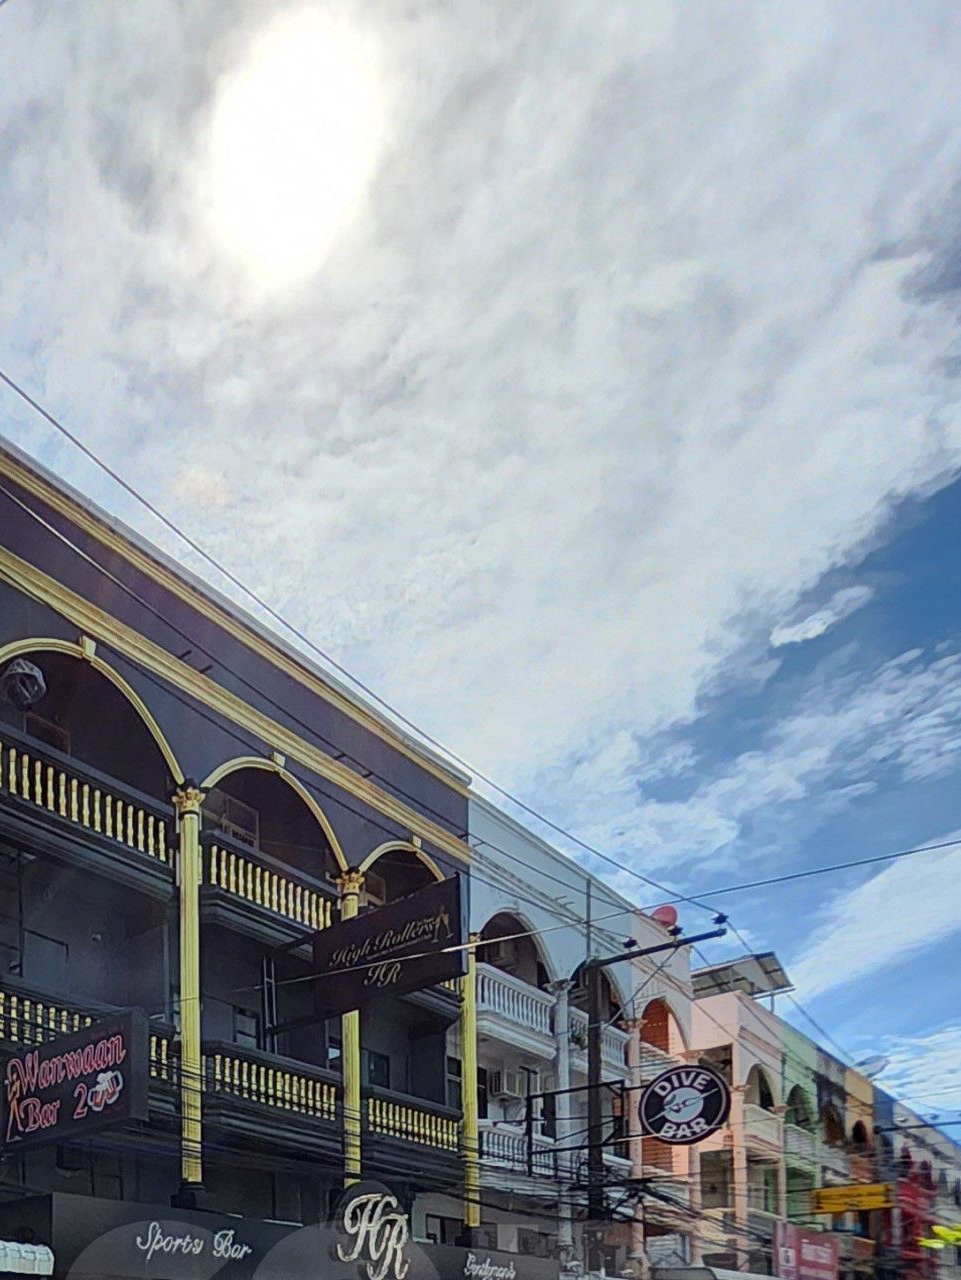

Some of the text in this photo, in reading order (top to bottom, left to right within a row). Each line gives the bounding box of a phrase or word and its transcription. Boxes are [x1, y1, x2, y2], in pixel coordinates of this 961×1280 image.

[329, 919, 433, 967] High Rollers
[7, 1035, 126, 1095] Wanwaan
[653, 1072, 711, 1096] DIVE
[19, 1097, 60, 1132] Bar
[660, 1117, 709, 1138] BAR
[136, 1221, 252, 1260] Sports Bar
[337, 1193, 411, 1280] HR
